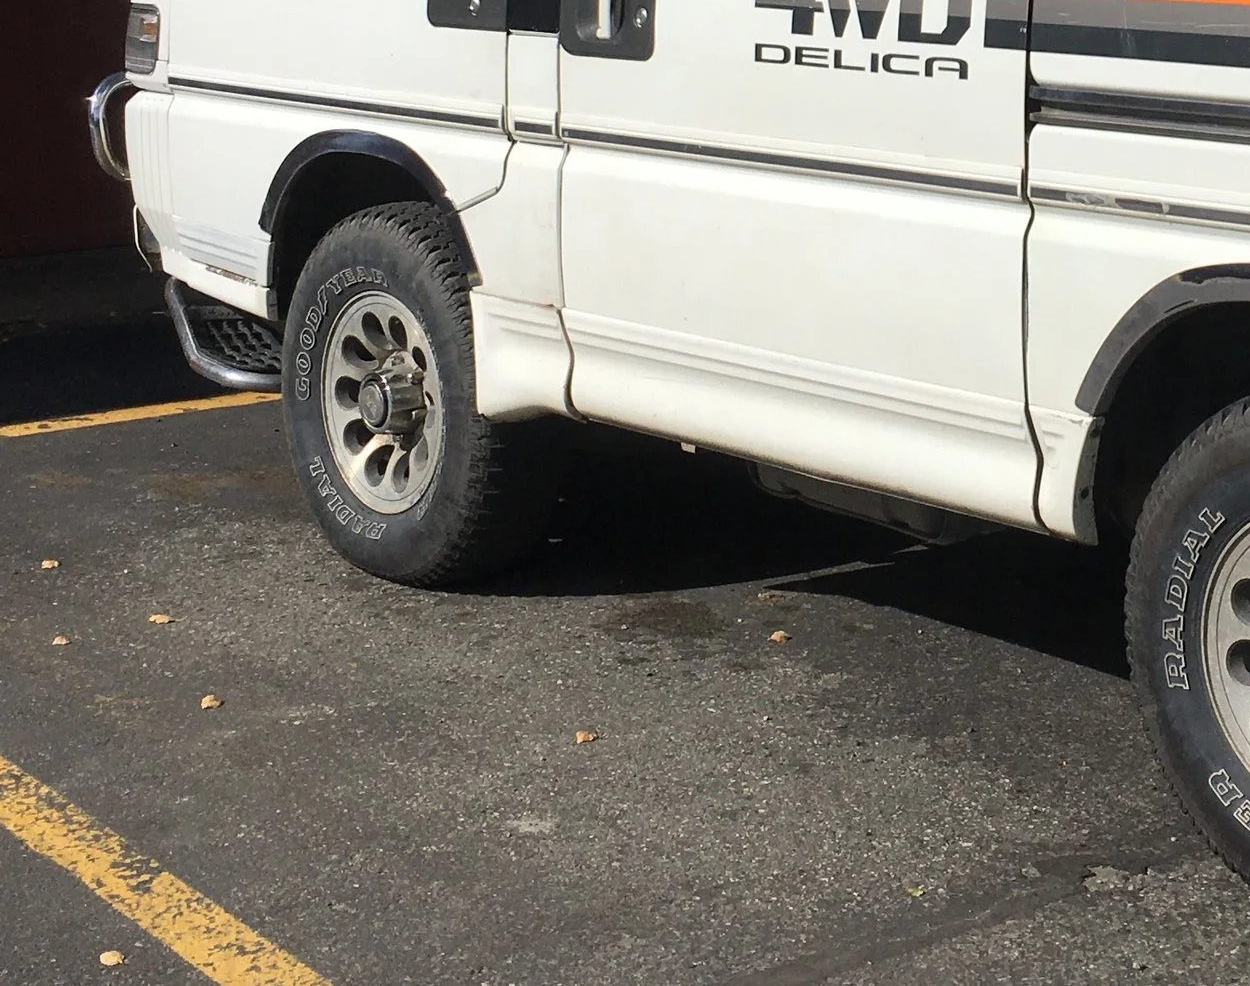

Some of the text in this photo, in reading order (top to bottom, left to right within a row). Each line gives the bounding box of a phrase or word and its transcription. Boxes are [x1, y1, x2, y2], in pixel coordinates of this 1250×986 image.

[754, 43, 969, 80] DELICA
[310, 456, 387, 540] RADIAL
[1161, 507, 1228, 691] RADIAL
